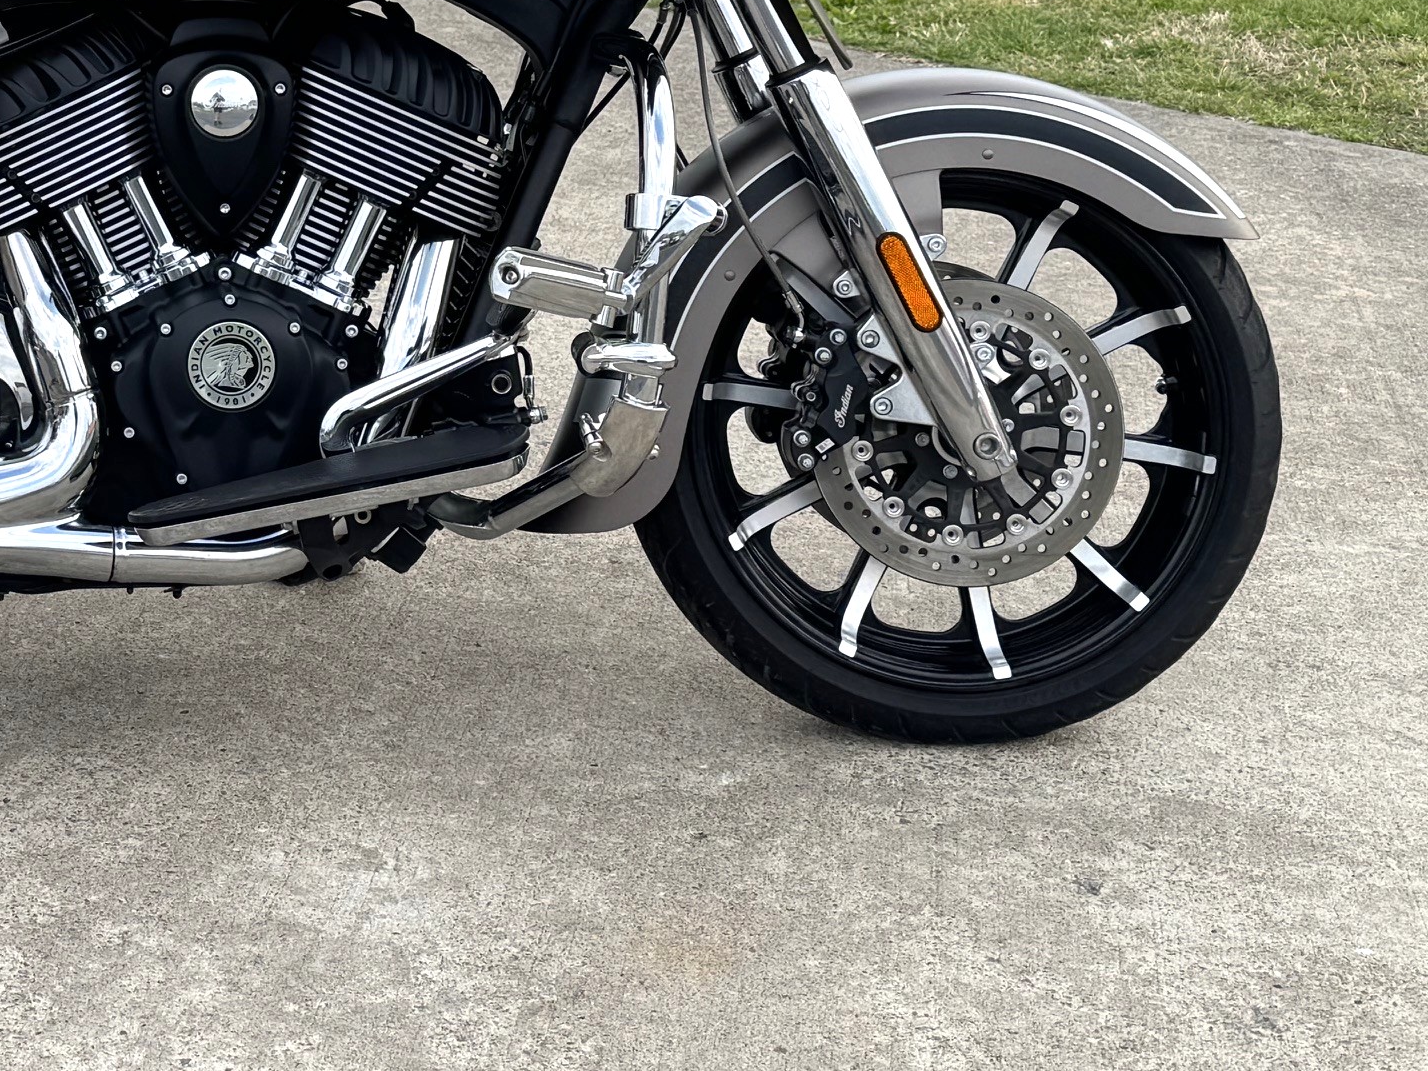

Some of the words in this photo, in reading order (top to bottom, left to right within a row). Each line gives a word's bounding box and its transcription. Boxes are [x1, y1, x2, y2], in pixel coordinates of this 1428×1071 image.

[191, 336, 210, 390] INDIAN
[212, 325, 272, 391] MOTORCYCLE
[215, 395, 247, 406] 1901
[833, 383, 855, 429] Indian
